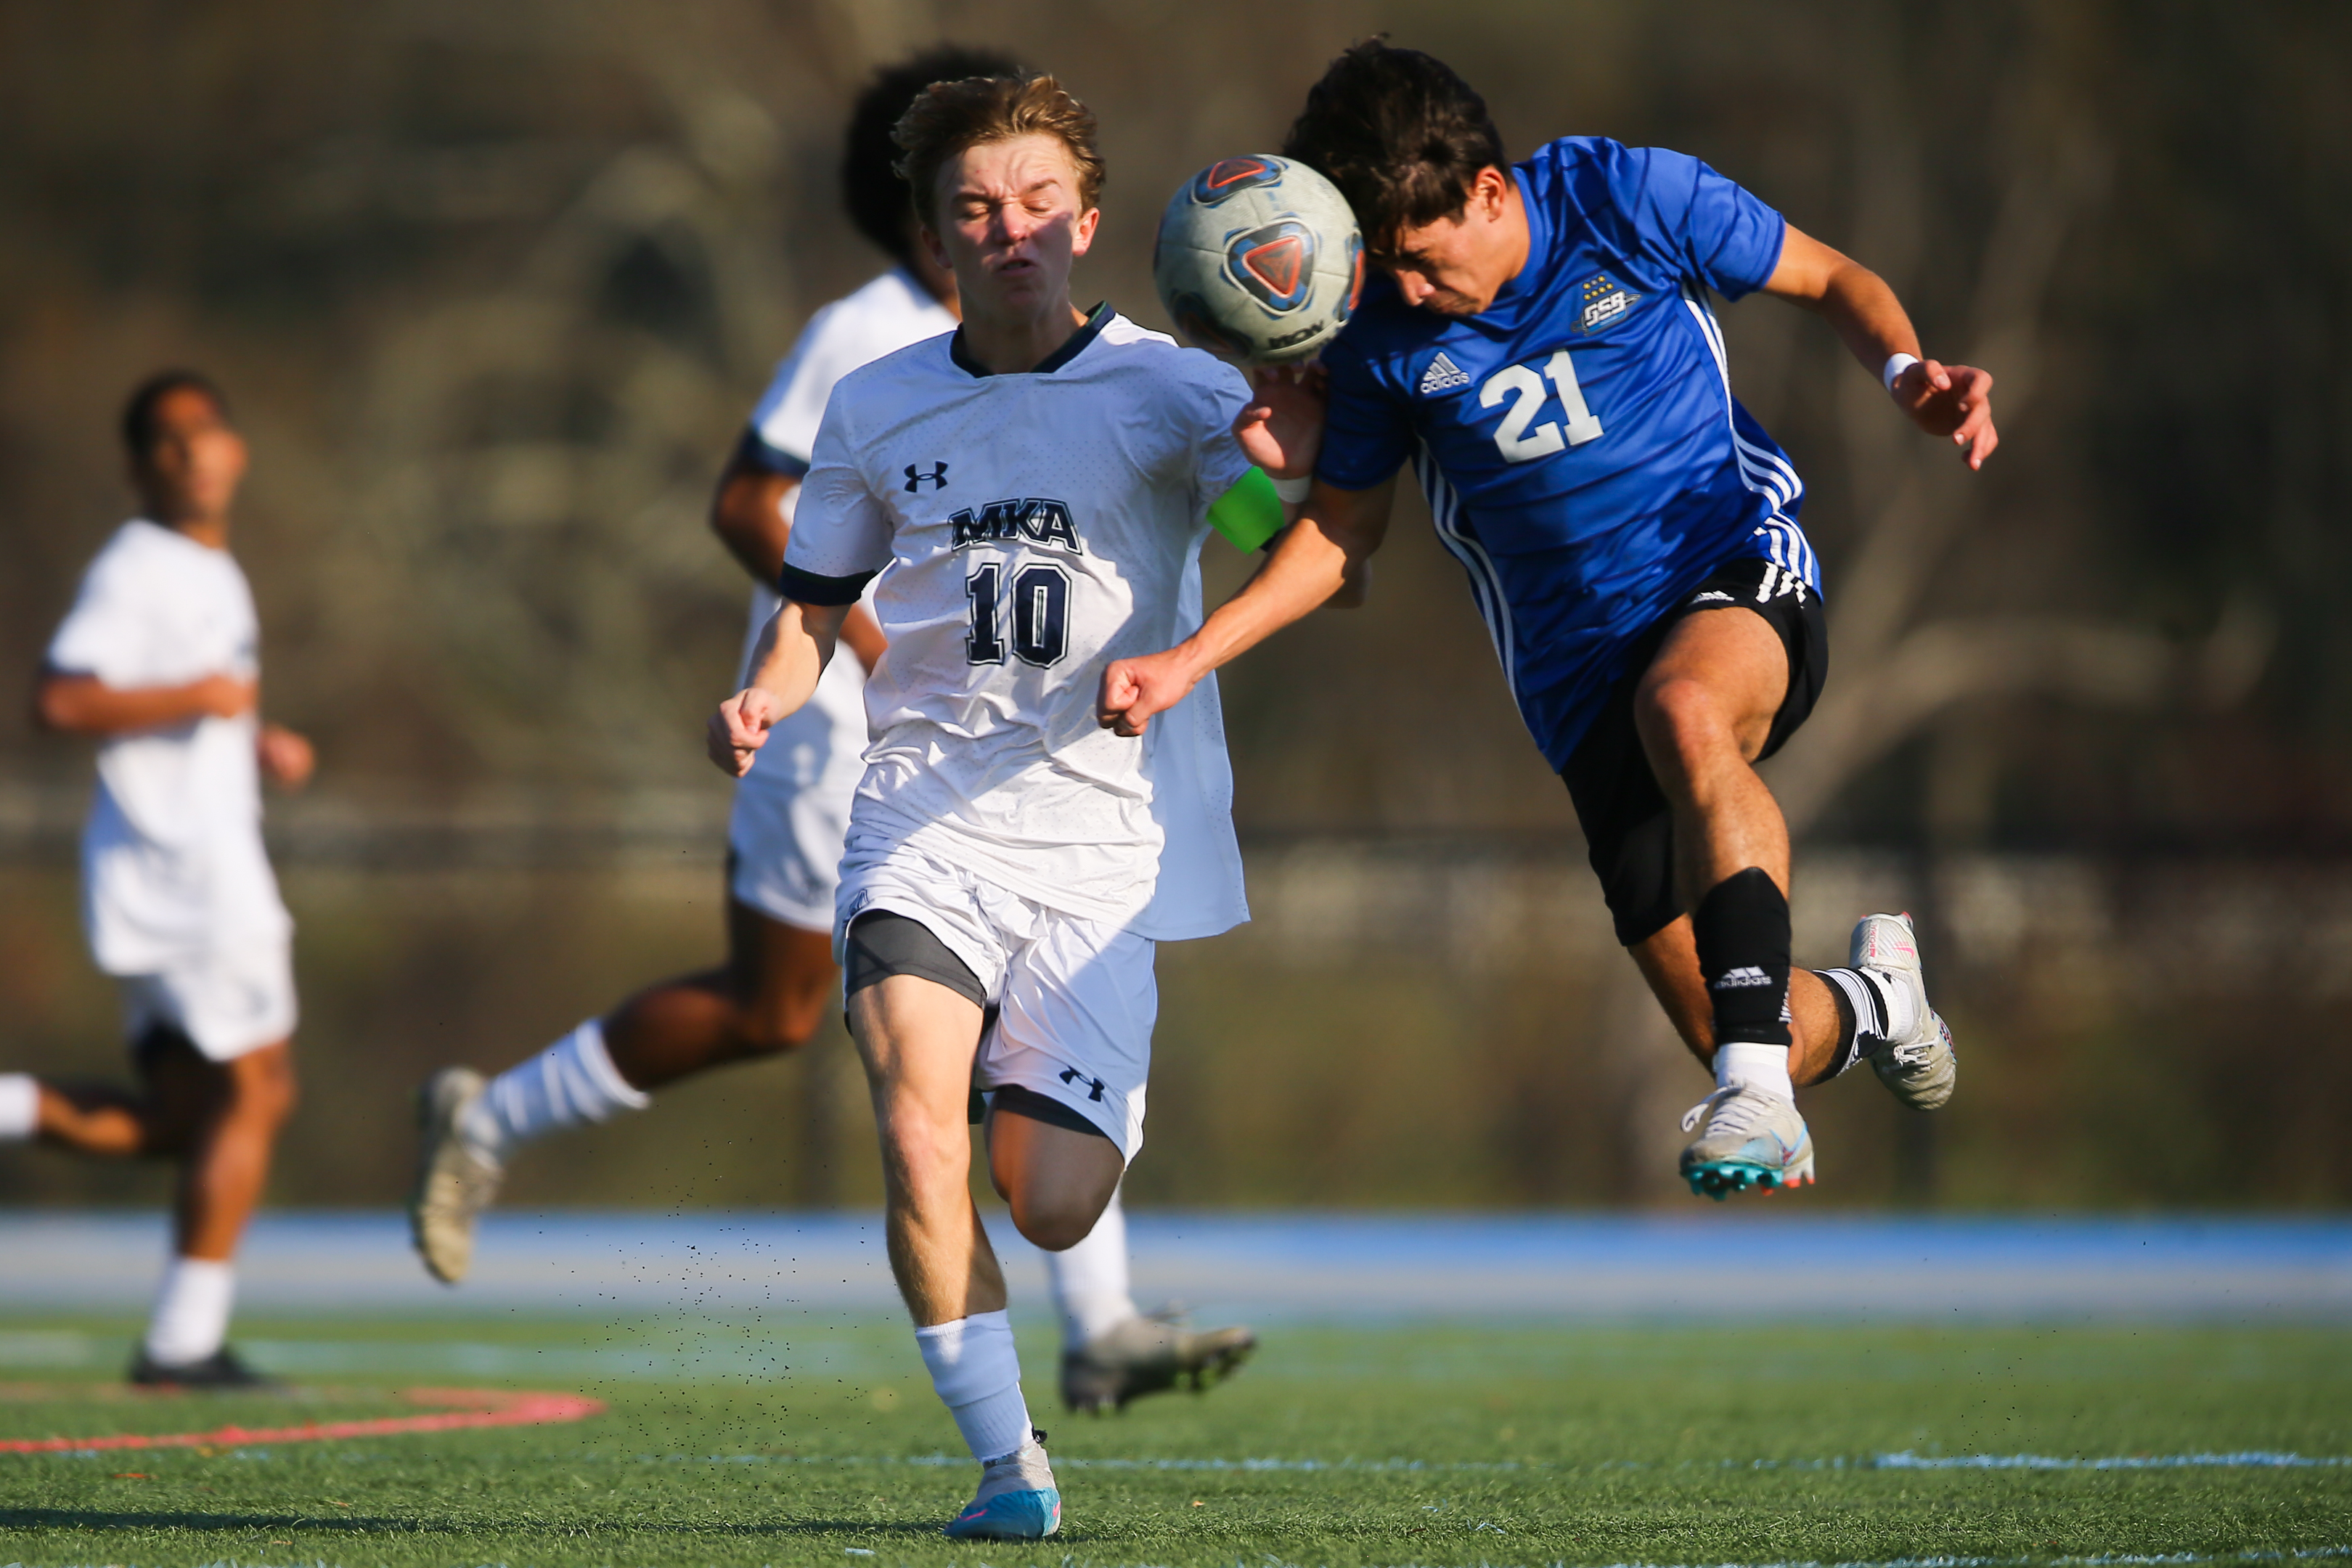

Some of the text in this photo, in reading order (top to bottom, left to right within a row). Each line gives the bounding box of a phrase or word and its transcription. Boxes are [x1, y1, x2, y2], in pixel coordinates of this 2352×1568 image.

[1420, 371, 1471, 394] adidas
[1479, 349, 1604, 463] 21
[947, 497, 1082, 555] MKA
[964, 563, 1072, 669] 10
[1714, 976, 1773, 989] adidas
